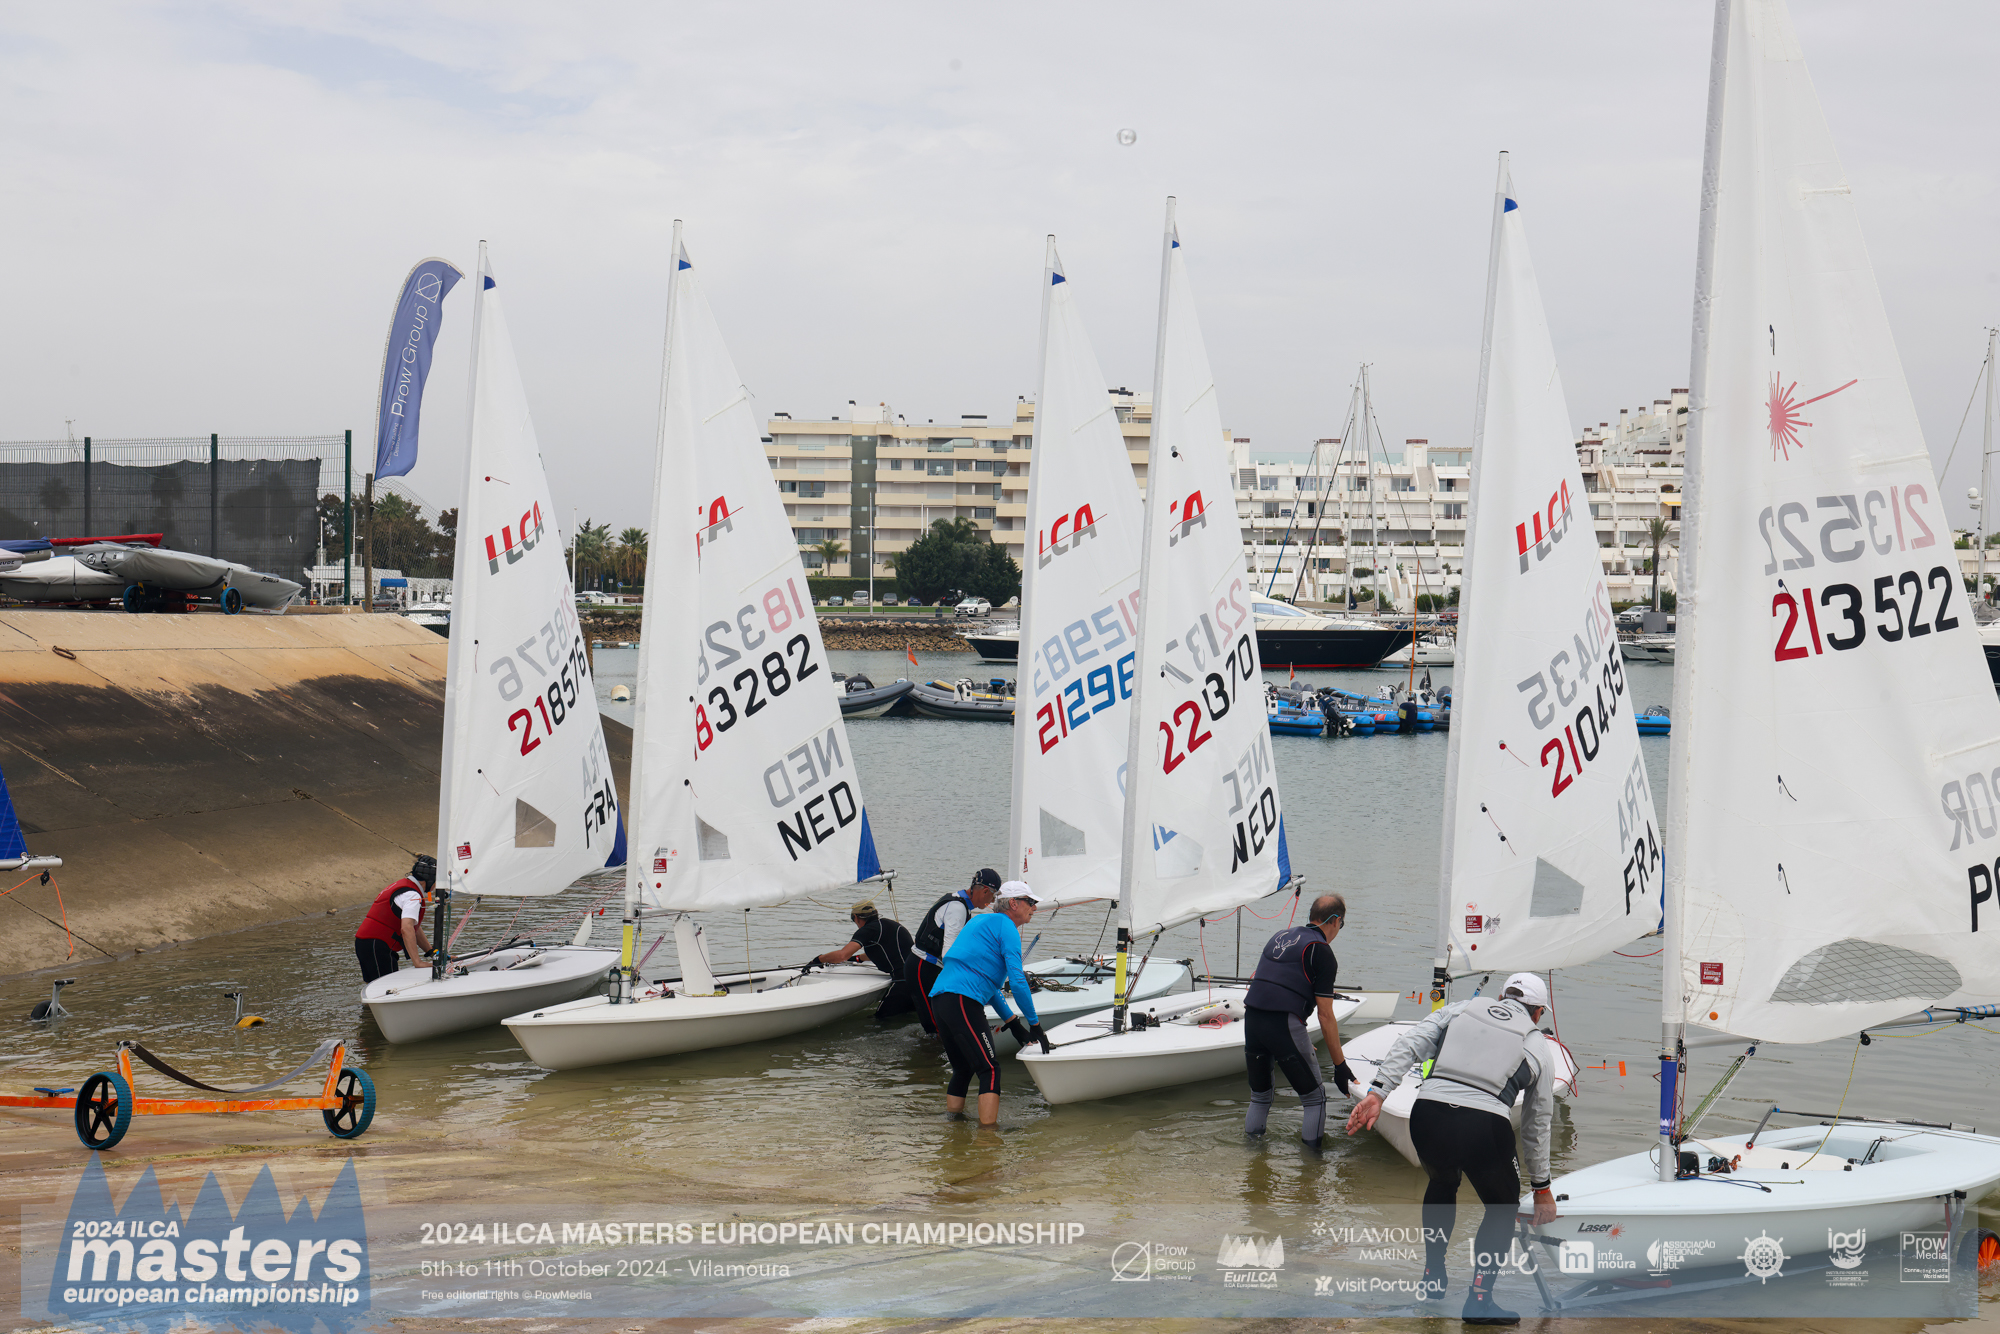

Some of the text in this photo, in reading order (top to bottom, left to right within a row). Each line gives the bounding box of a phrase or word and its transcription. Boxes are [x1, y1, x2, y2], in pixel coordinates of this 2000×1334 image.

[391, 367, 413, 417] Prow
[402, 305, 429, 364] Group
[485, 500, 545, 576] ILCA
[1515, 478, 1574, 575] ILCA
[1772, 565, 1959, 662] 213522
[507, 635, 587, 757] 218576
[694, 633, 819, 762] 83282
[1540, 640, 1624, 799] 210435
[584, 778, 616, 850] FRA
[777, 780, 857, 861] NED
[1232, 787, 1277, 875] NED
[1624, 820, 1660, 916] FRA
[1577, 1222, 1612, 1232] Laser
